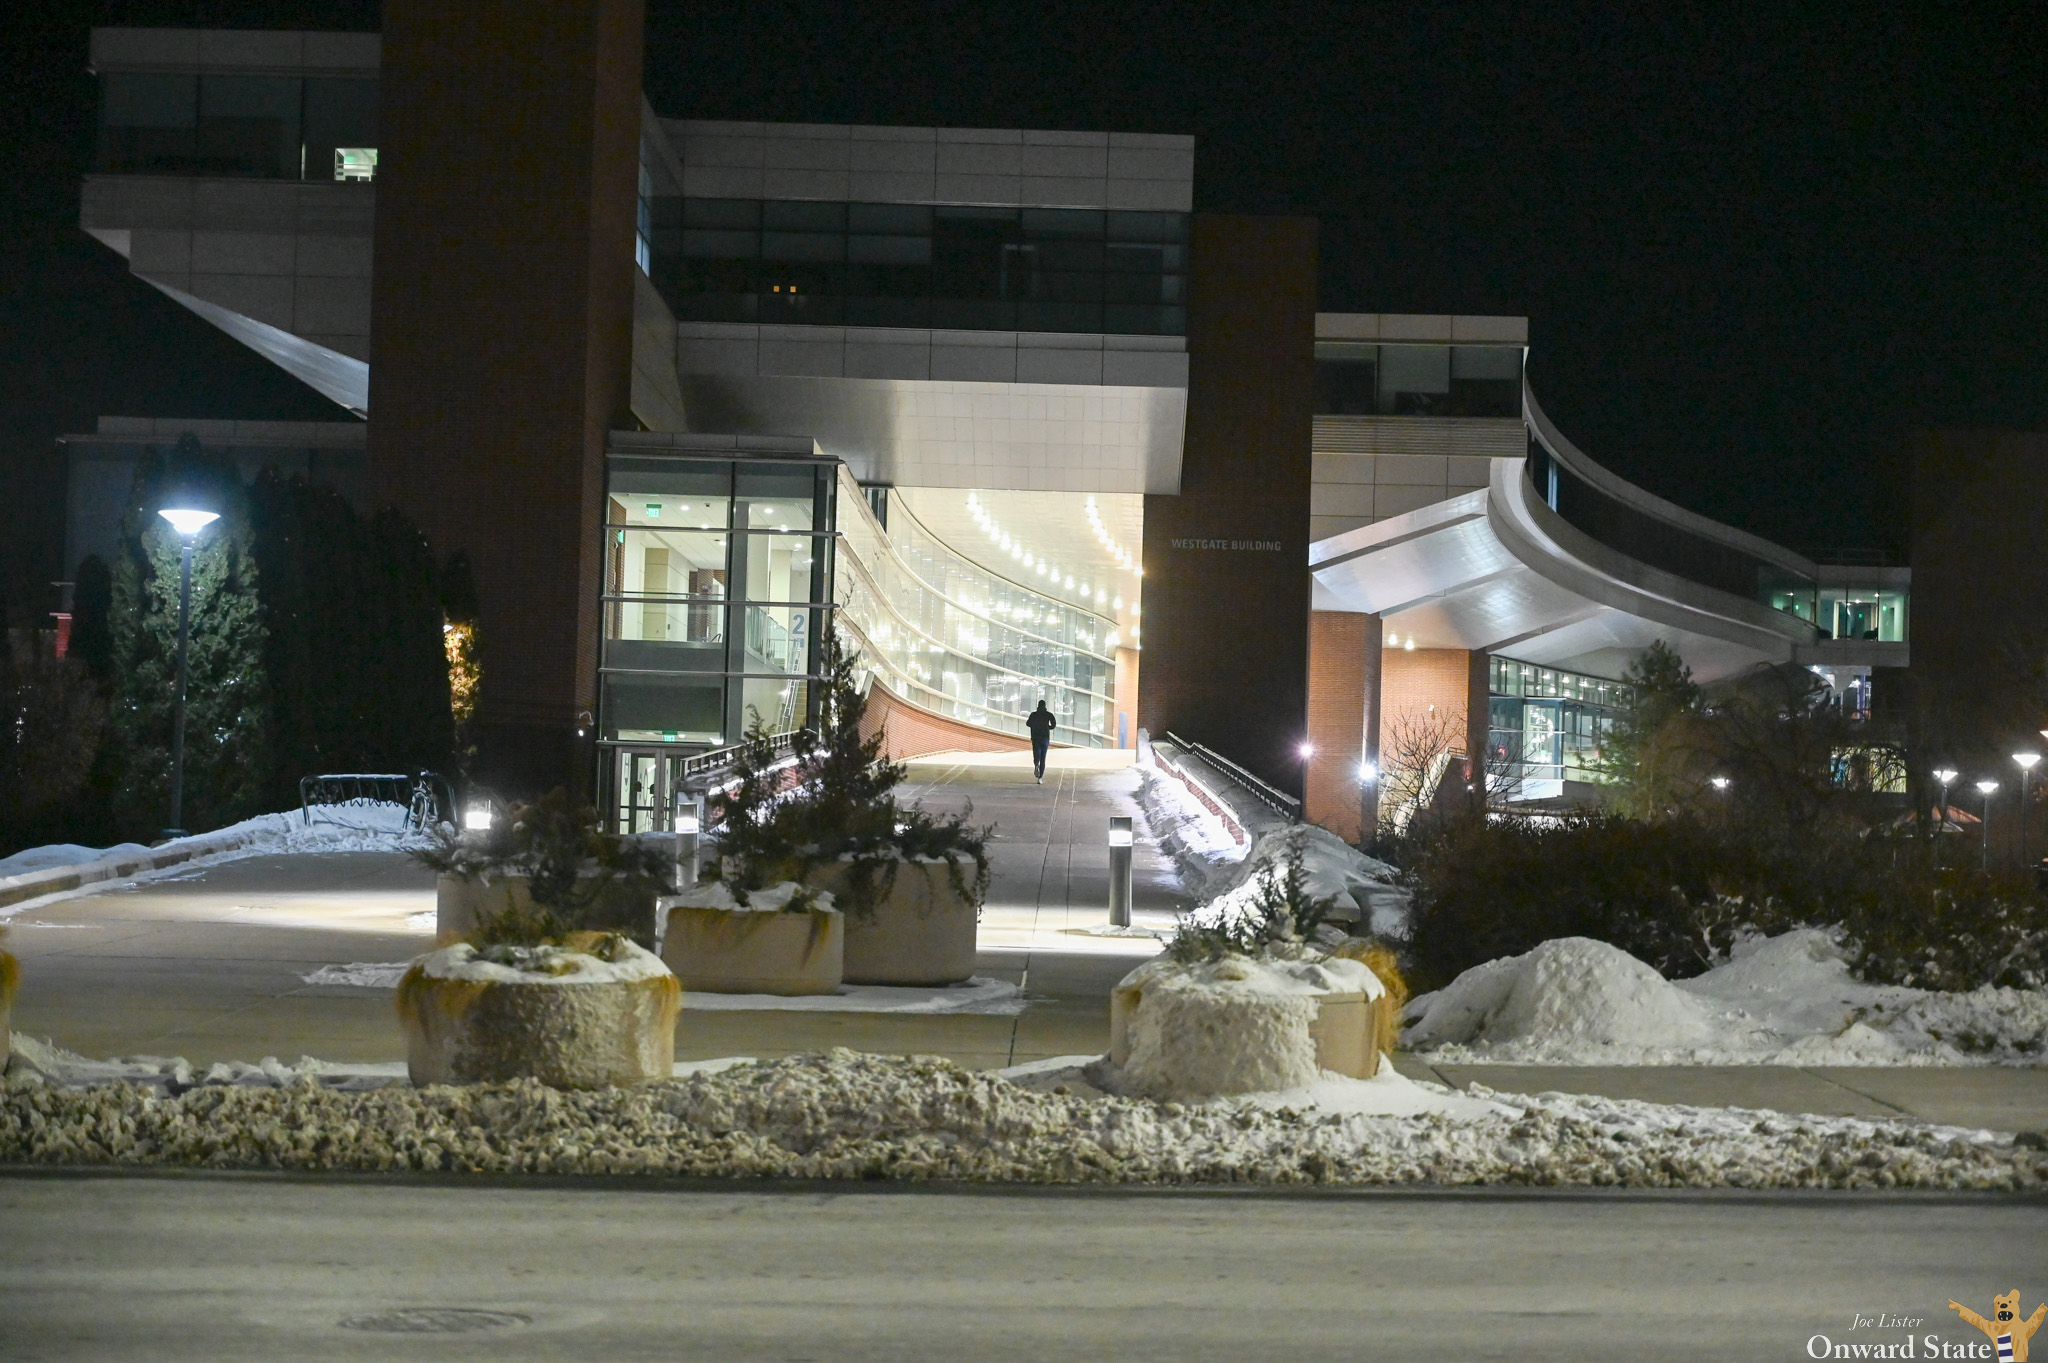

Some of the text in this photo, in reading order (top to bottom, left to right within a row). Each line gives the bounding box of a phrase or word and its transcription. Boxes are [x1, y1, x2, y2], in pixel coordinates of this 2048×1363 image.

[1171, 538, 1281, 552] WESTGATE BUILDING
[792, 614, 805, 635] 2
